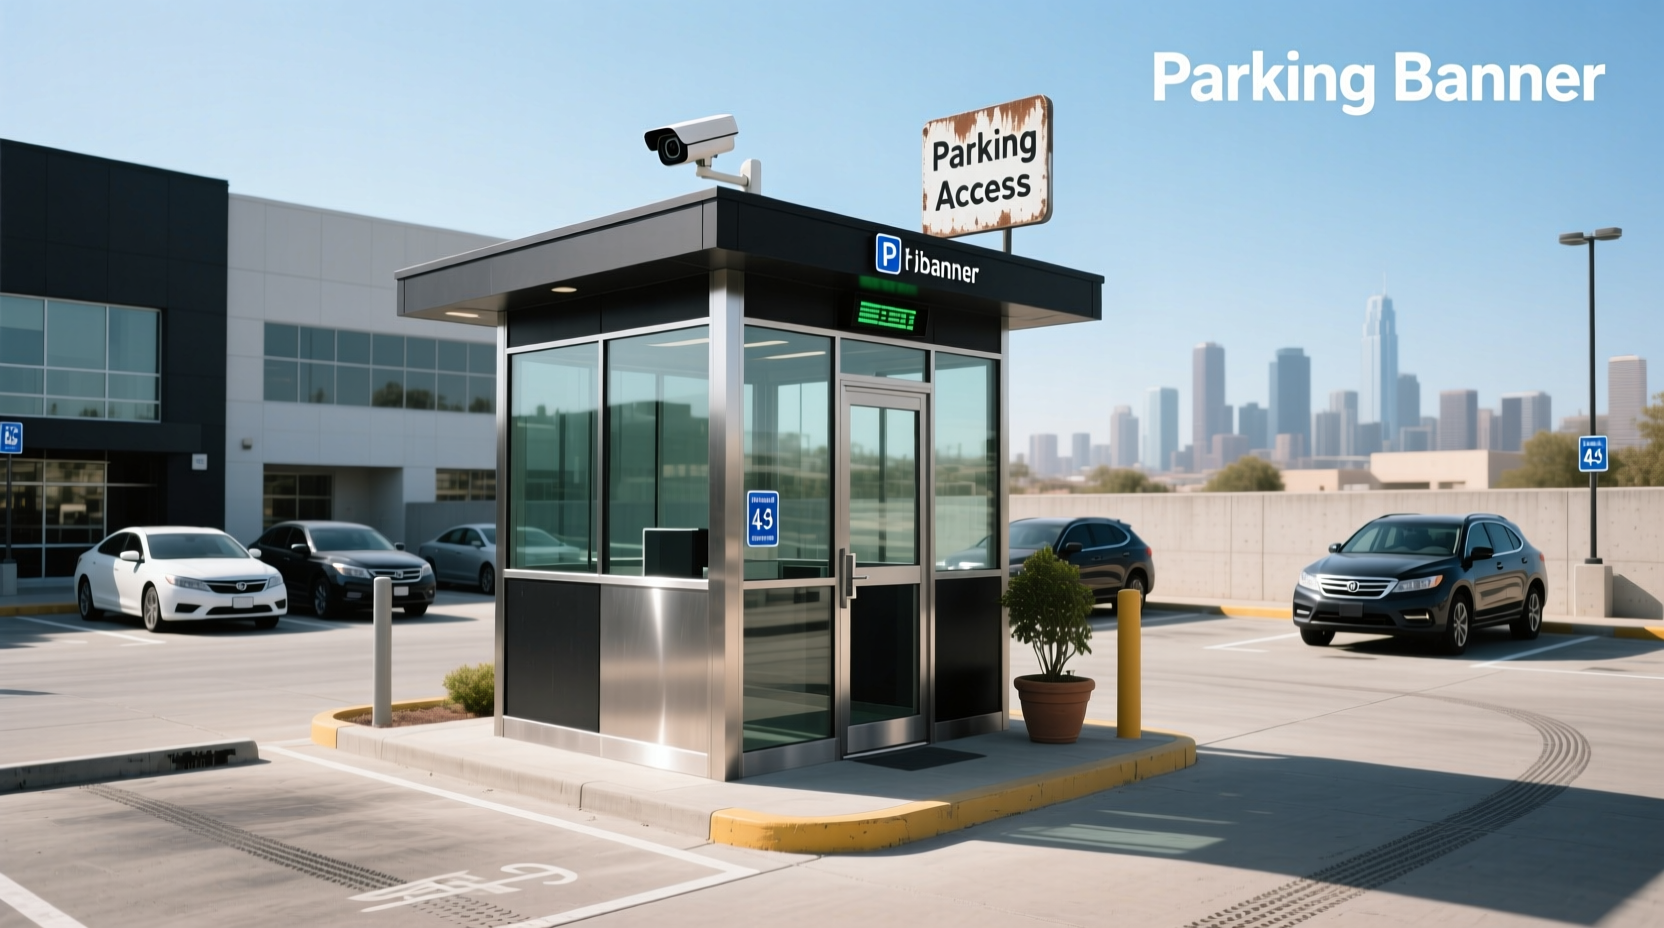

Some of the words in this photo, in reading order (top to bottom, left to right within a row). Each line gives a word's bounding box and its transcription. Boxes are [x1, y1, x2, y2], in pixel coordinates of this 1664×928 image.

[932, 128, 1037, 172] Parking
[935, 173, 1031, 211] Access
[883, 241, 897, 267] P
[752, 508, 773, 530] 49
